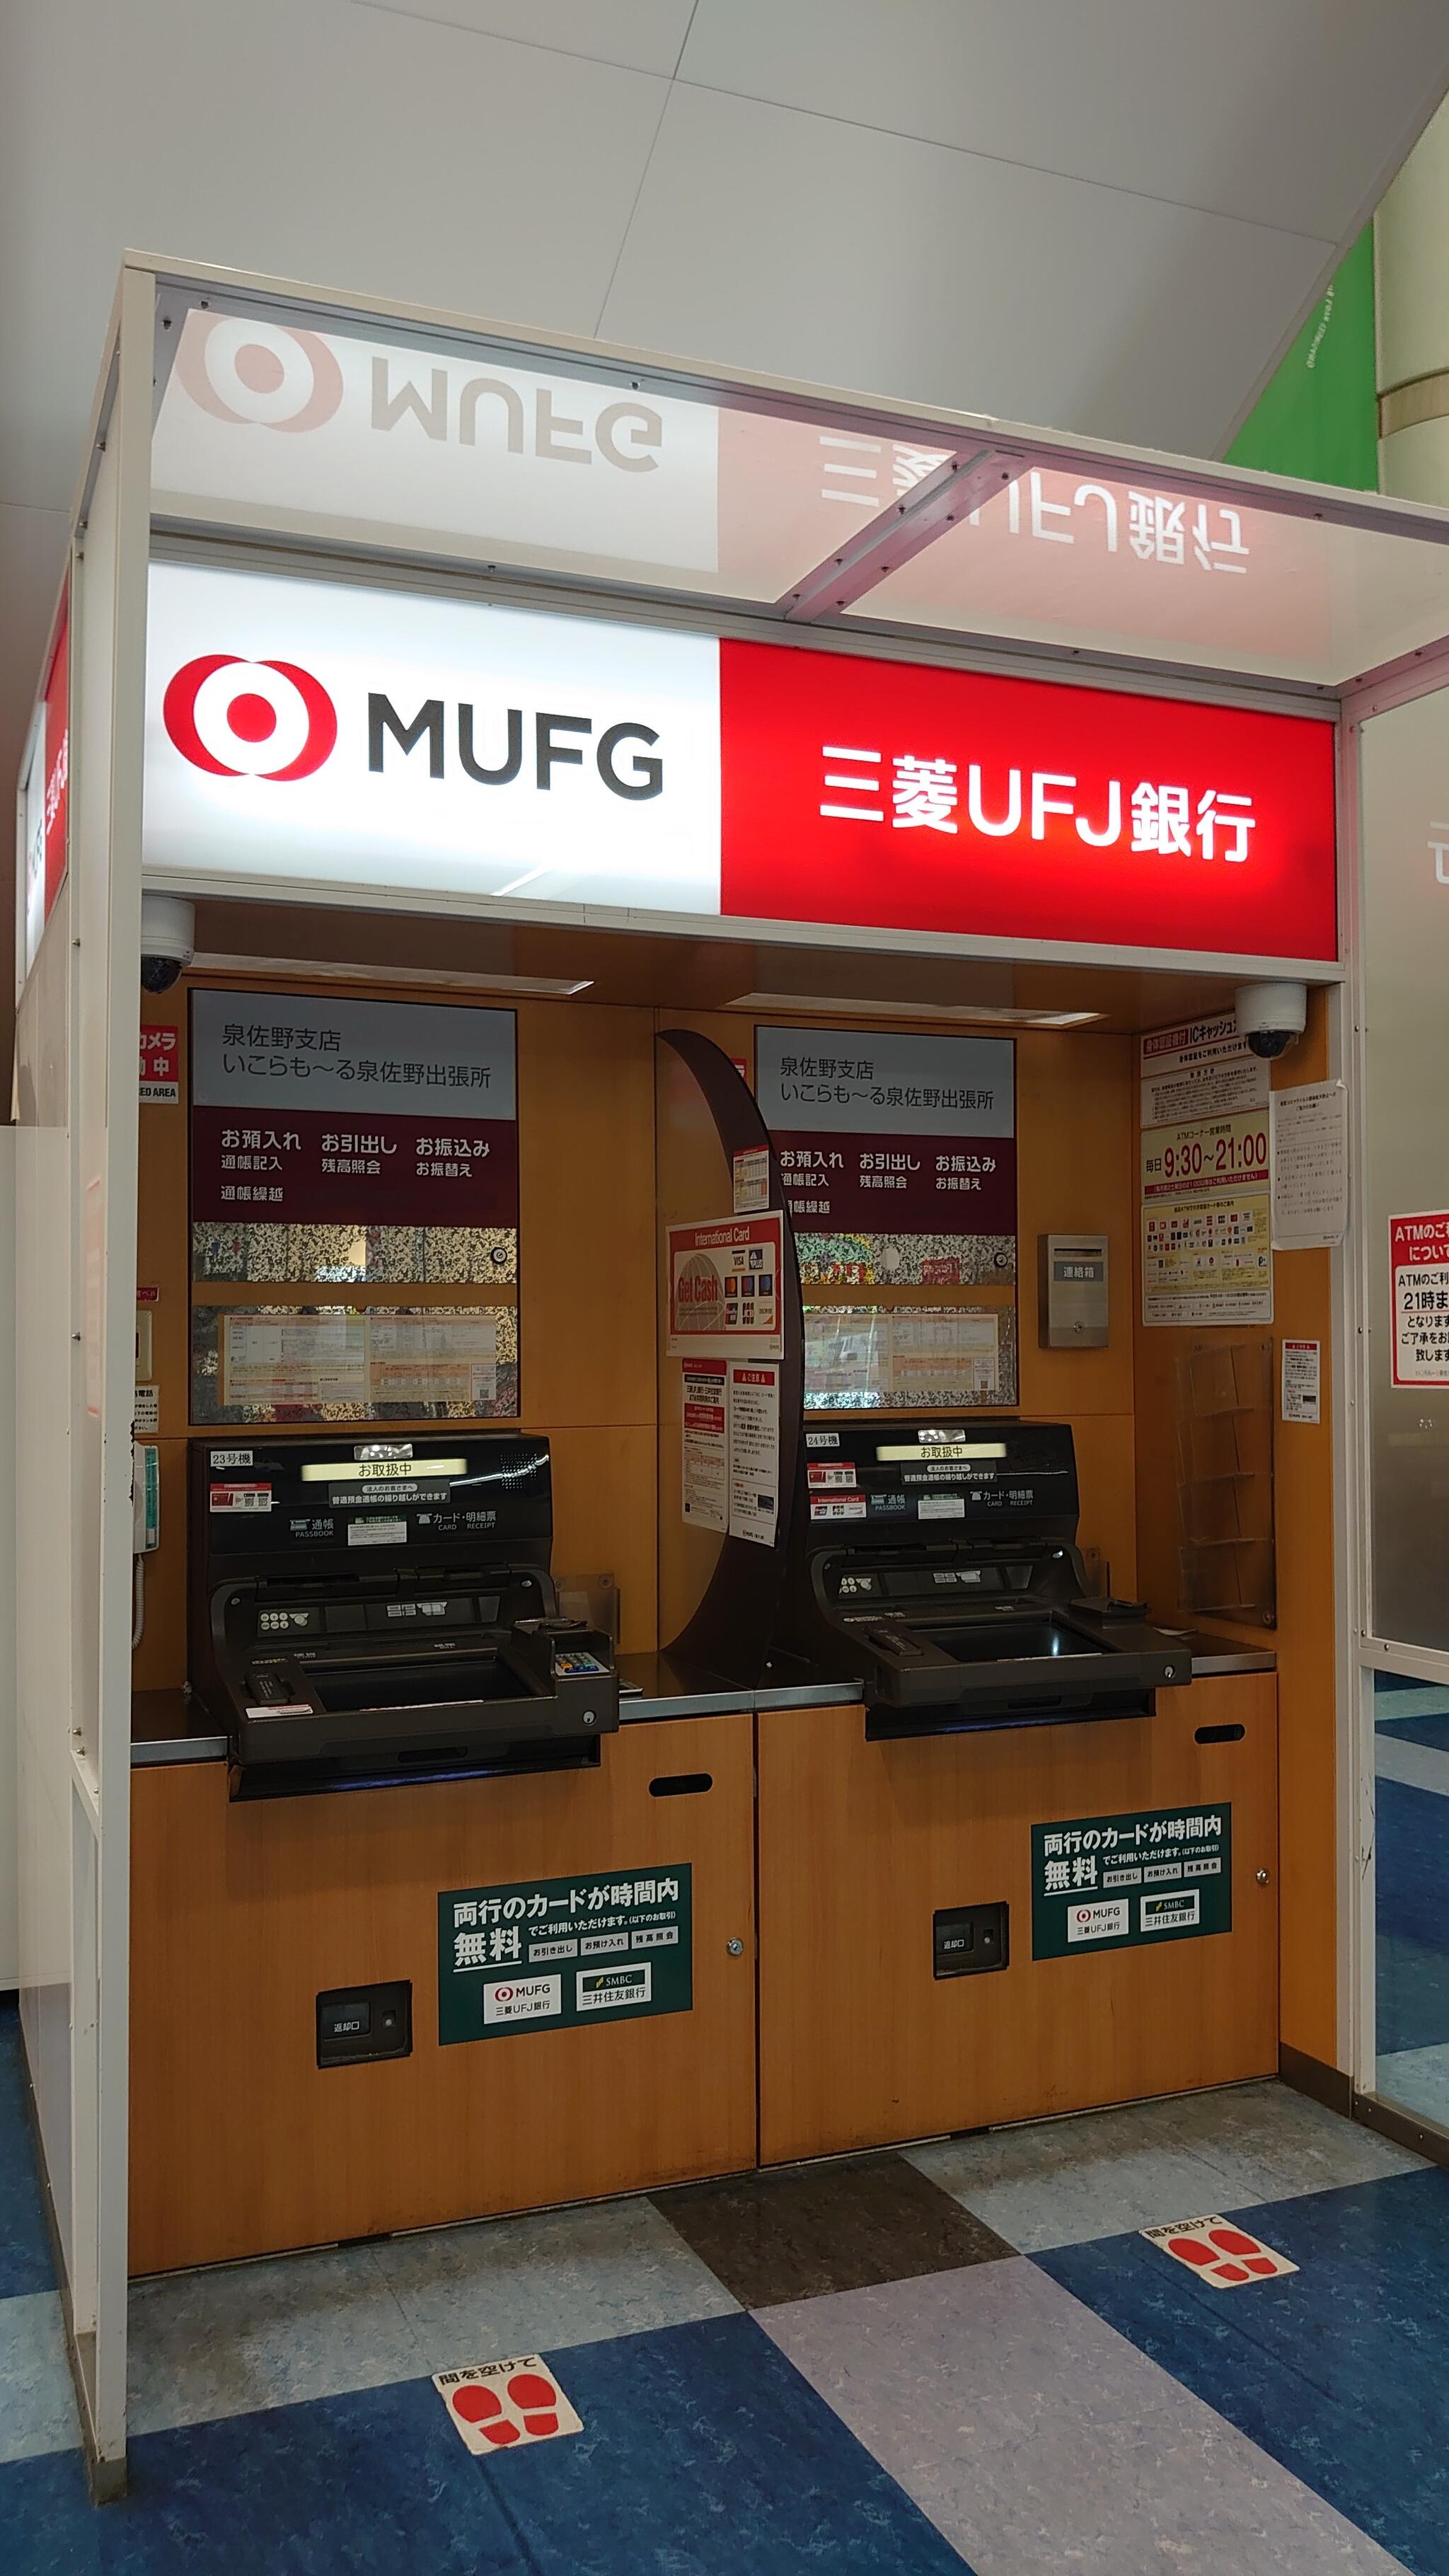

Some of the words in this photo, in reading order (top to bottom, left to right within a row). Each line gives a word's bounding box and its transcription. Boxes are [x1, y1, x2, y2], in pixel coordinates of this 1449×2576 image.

[367, 691, 664, 802] MUFG
[819, 744, 1257, 863] 三菱UFJ銀行
[222, 1023, 341, 1053] 泉佐野支店
[780, 1056, 874, 1080] 泉佐野支店
[153, 1087, 176, 1097] AREA
[221, 1128, 301, 1151] お預入れ
[321, 1133, 398, 1155] お引出し
[415, 1136, 490, 1157] お振込み
[221, 1154, 283, 1171] 通帳記入
[321, 1157, 381, 1175] 残高照会
[416, 1161, 472, 1178] お振替え
[780, 1150, 844, 1169] お預入れ
[859, 1153, 920, 1172] お引出し
[935, 1155, 997, 1173] お振込み
[780, 1172, 830, 1188] 通帳記入
[859, 1175, 908, 1190] 残高照会
[935, 1177, 982, 1191] お振替え
[221, 1186, 284, 1203] 通帳繰越
[695, 1228, 733, 1247] International
[733, 1225, 750, 1242] Card
[733, 1256, 744, 1266] VISA
[1063, 1266, 1095, 1279] 連絡箱
[678, 1276, 693, 1303] Get
[694, 1274, 718, 1303] Cash
[1404, 1290, 1449, 1310] 21時ま
[1401, 1331, 1449, 1345] ご了承をお
[807, 1435, 839, 1446] 24号機
[212, 1452, 251, 1465] 23号機
[920, 1446, 963, 1459] お取扱中
[358, 1463, 412, 1477] お取扱中
[366, 1484, 414, 1494] 法人のお客さまへ
[887, 1494, 906, 1505] 通帳
[295, 1530, 335, 1538] PASSBOOK
[437, 1523, 457, 1532] CARD
[466, 1521, 496, 1530] RECEIPT
[311, 1518, 335, 1531] 通帳
[432, 1511, 497, 1524] カード・明細票
[1044, 1814, 1222, 1857] 両行のカードが時間内
[1044, 1855, 1099, 1891] 無料
[453, 1877, 679, 1928] 両行のカードが時間内
[1092, 1907, 1121, 1919] MUFG
[1163, 1900, 1185, 1910] SMBC
[1145, 1911, 1196, 1927] 三井住友銀行
[453, 1925, 523, 1968] 無料
[533, 1944, 574, 1958] お引き出し
[584, 1937, 625, 1951] お預け入れ
[635, 1930, 674, 1944] 残高照会
[516, 1983, 551, 1997] MUFG
[606, 1974, 633, 1987] SMBC
[495, 1999, 551, 2017] 三菱UFJ銀行
[582, 1986, 646, 2006] 三井住友銀行
[334, 2021, 360, 2033] 返却口
[1144, 2215, 1224, 2239] 間を空けて
[437, 2356, 538, 2386] 間を空けて
